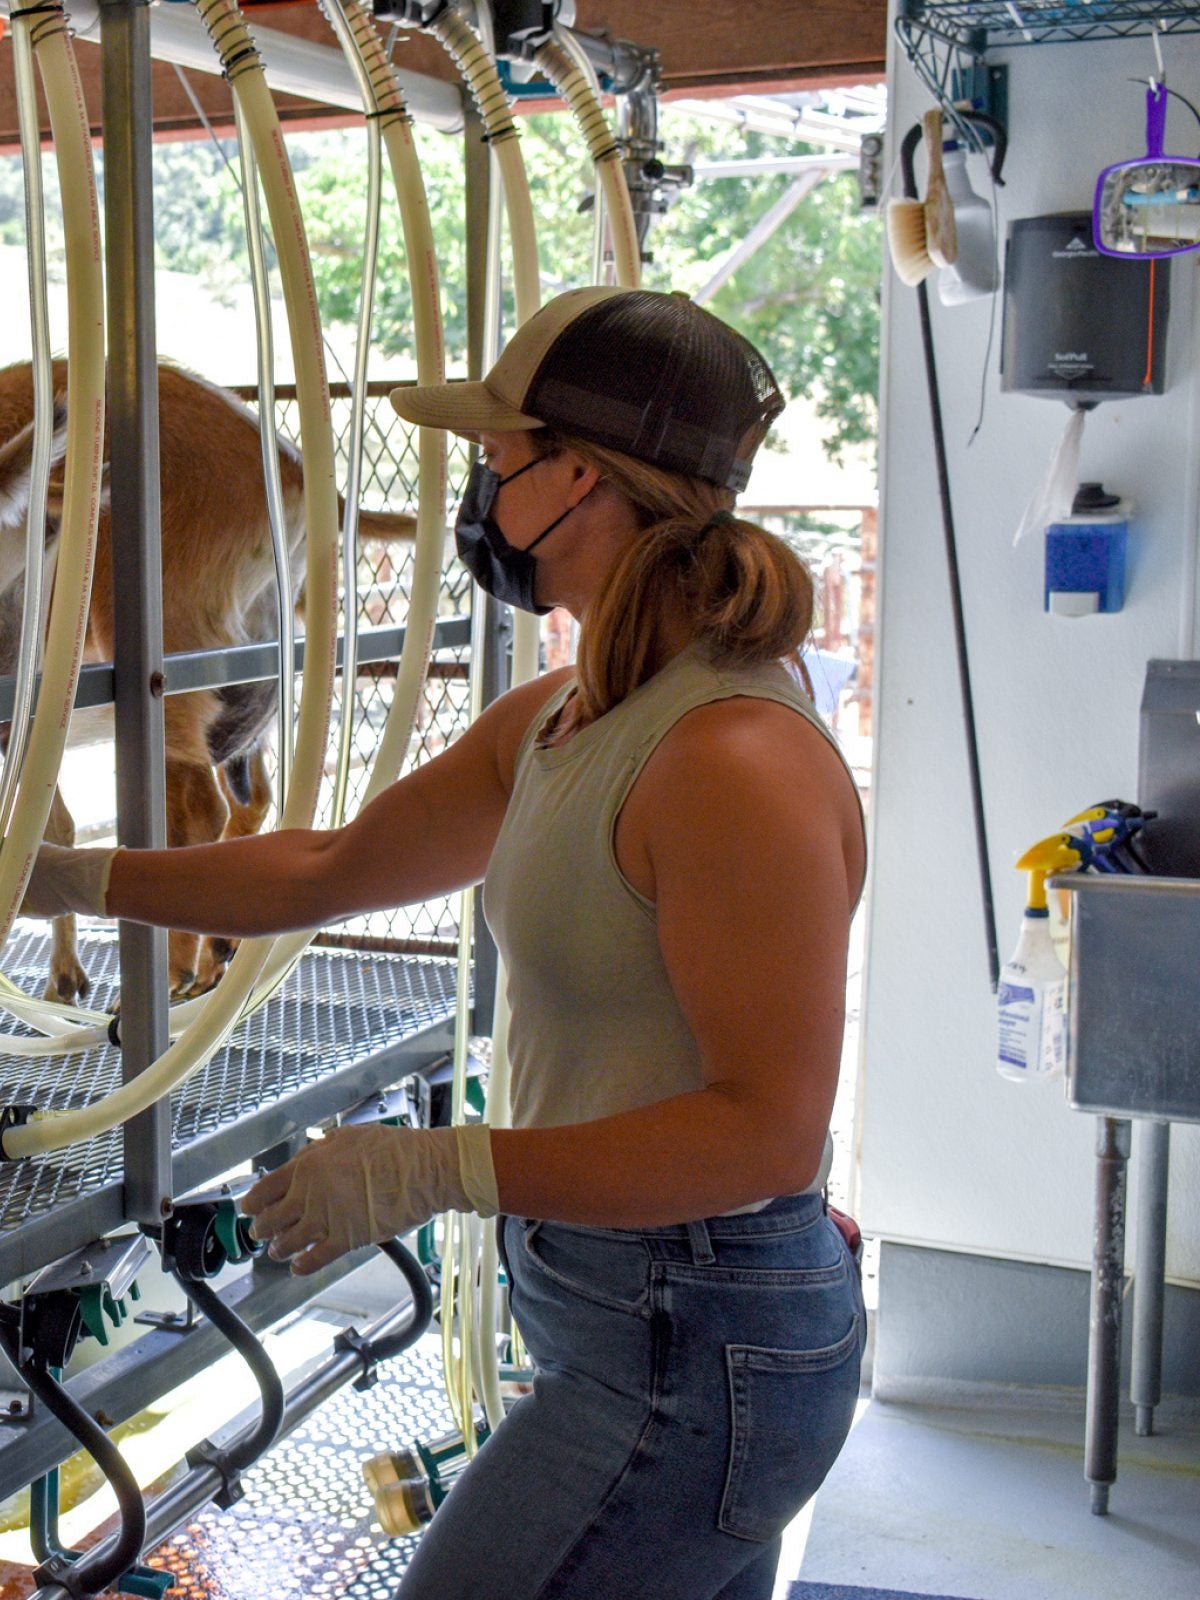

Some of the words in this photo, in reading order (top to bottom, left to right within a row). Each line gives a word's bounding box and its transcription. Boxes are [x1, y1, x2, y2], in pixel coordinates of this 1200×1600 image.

[87, 497, 96, 535] COMPLIES
[85, 537, 93, 557] WITH
[74, 595, 86, 640] STANDARDS
[71, 641, 79, 657] FOR
[68, 658, 77, 677] RAW
[65, 678, 74, 696] MILK
[59, 697, 70, 729] SERVICE
